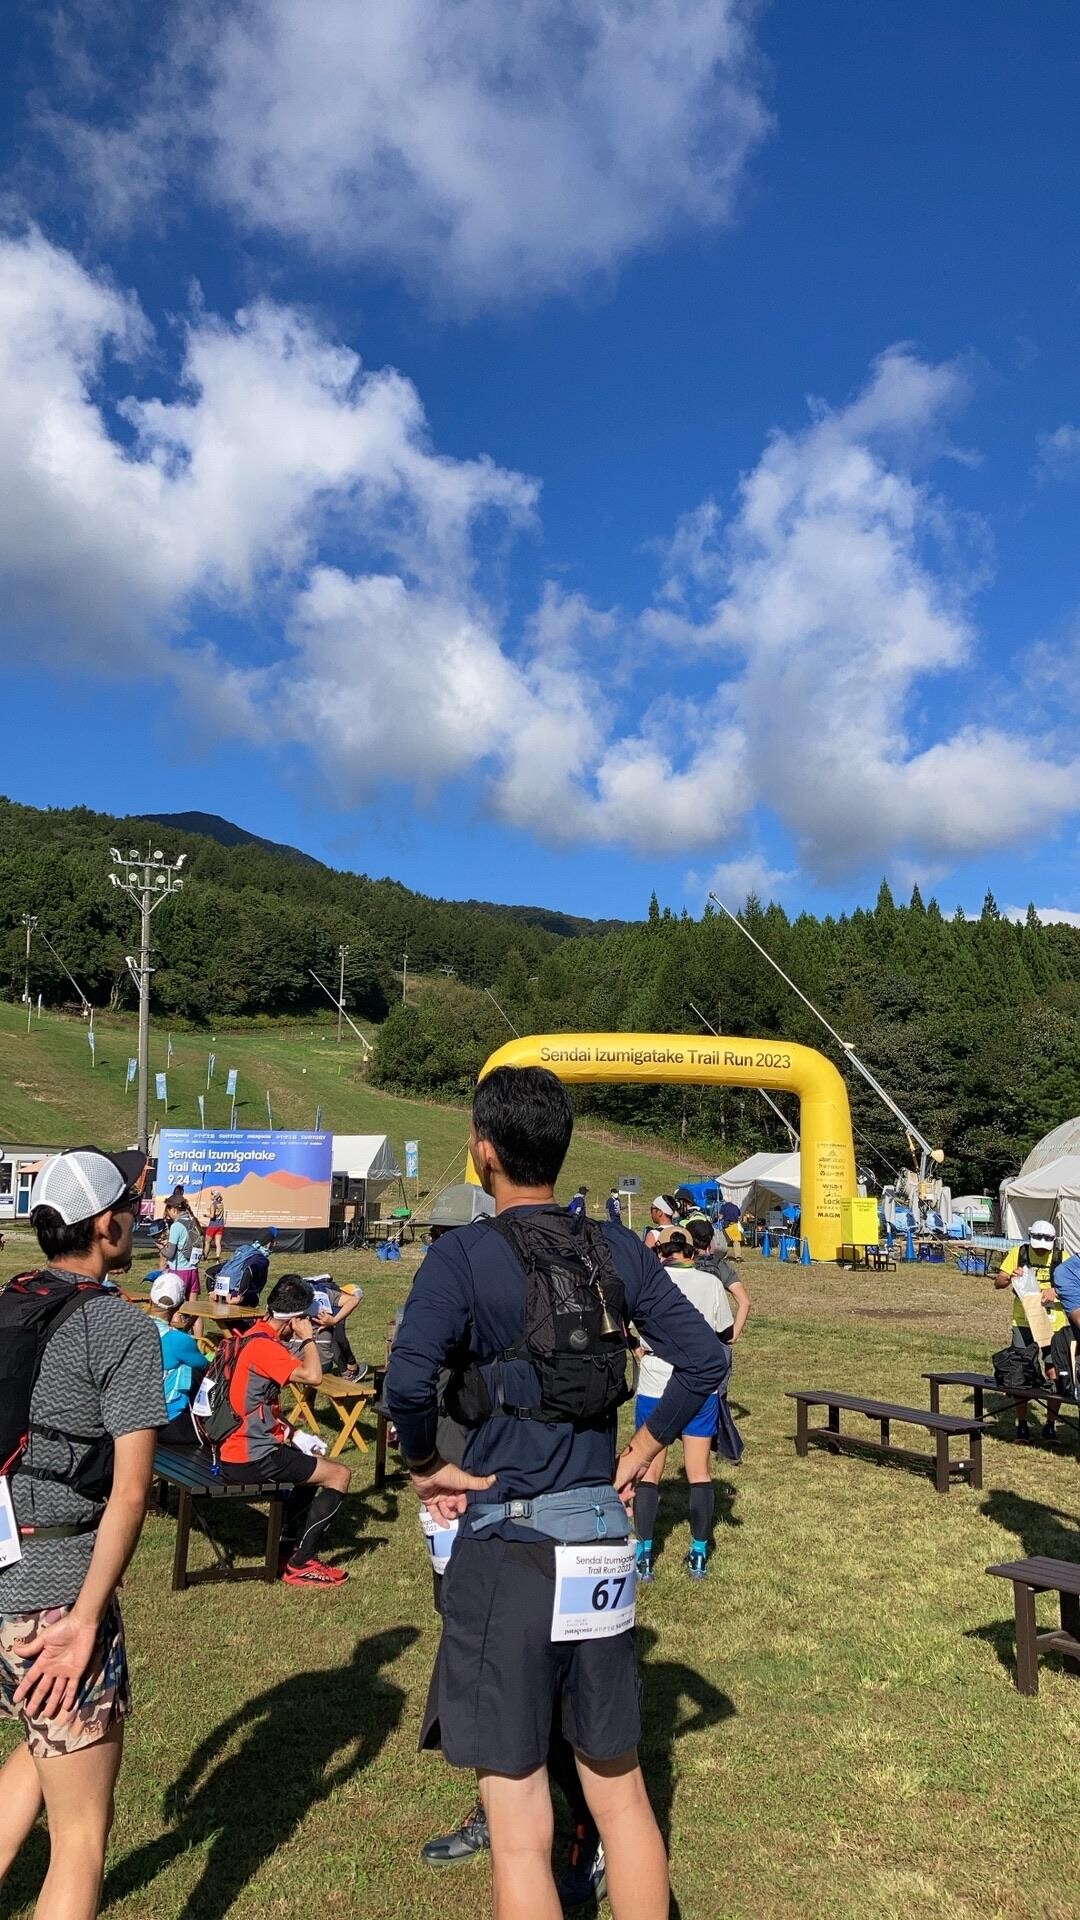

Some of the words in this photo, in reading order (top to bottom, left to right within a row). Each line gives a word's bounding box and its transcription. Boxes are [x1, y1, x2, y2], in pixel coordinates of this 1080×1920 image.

[540, 1048, 591, 1062] Sendai
[596, 1049, 684, 1065] Izumigatake
[687, 1050, 720, 1065] Trail
[723, 1052, 753, 1066] Run
[756, 1054, 791, 1068] 2023
[168, 1149, 206, 1159] Sendai
[208, 1149, 276, 1162] Izumigatake
[168, 1162, 190, 1172] Trail
[192, 1163, 212, 1172] Run
[214, 1163, 241, 1173] 2023
[168, 1175, 190, 1185] 9.24
[576, 1556, 602, 1565] Sendai
[588, 1566, 602, 1575] Trail
[603, 1566, 617, 1574] Run
[617, 1563, 631, 1573] 2023
[592, 1577, 627, 1611] 67
